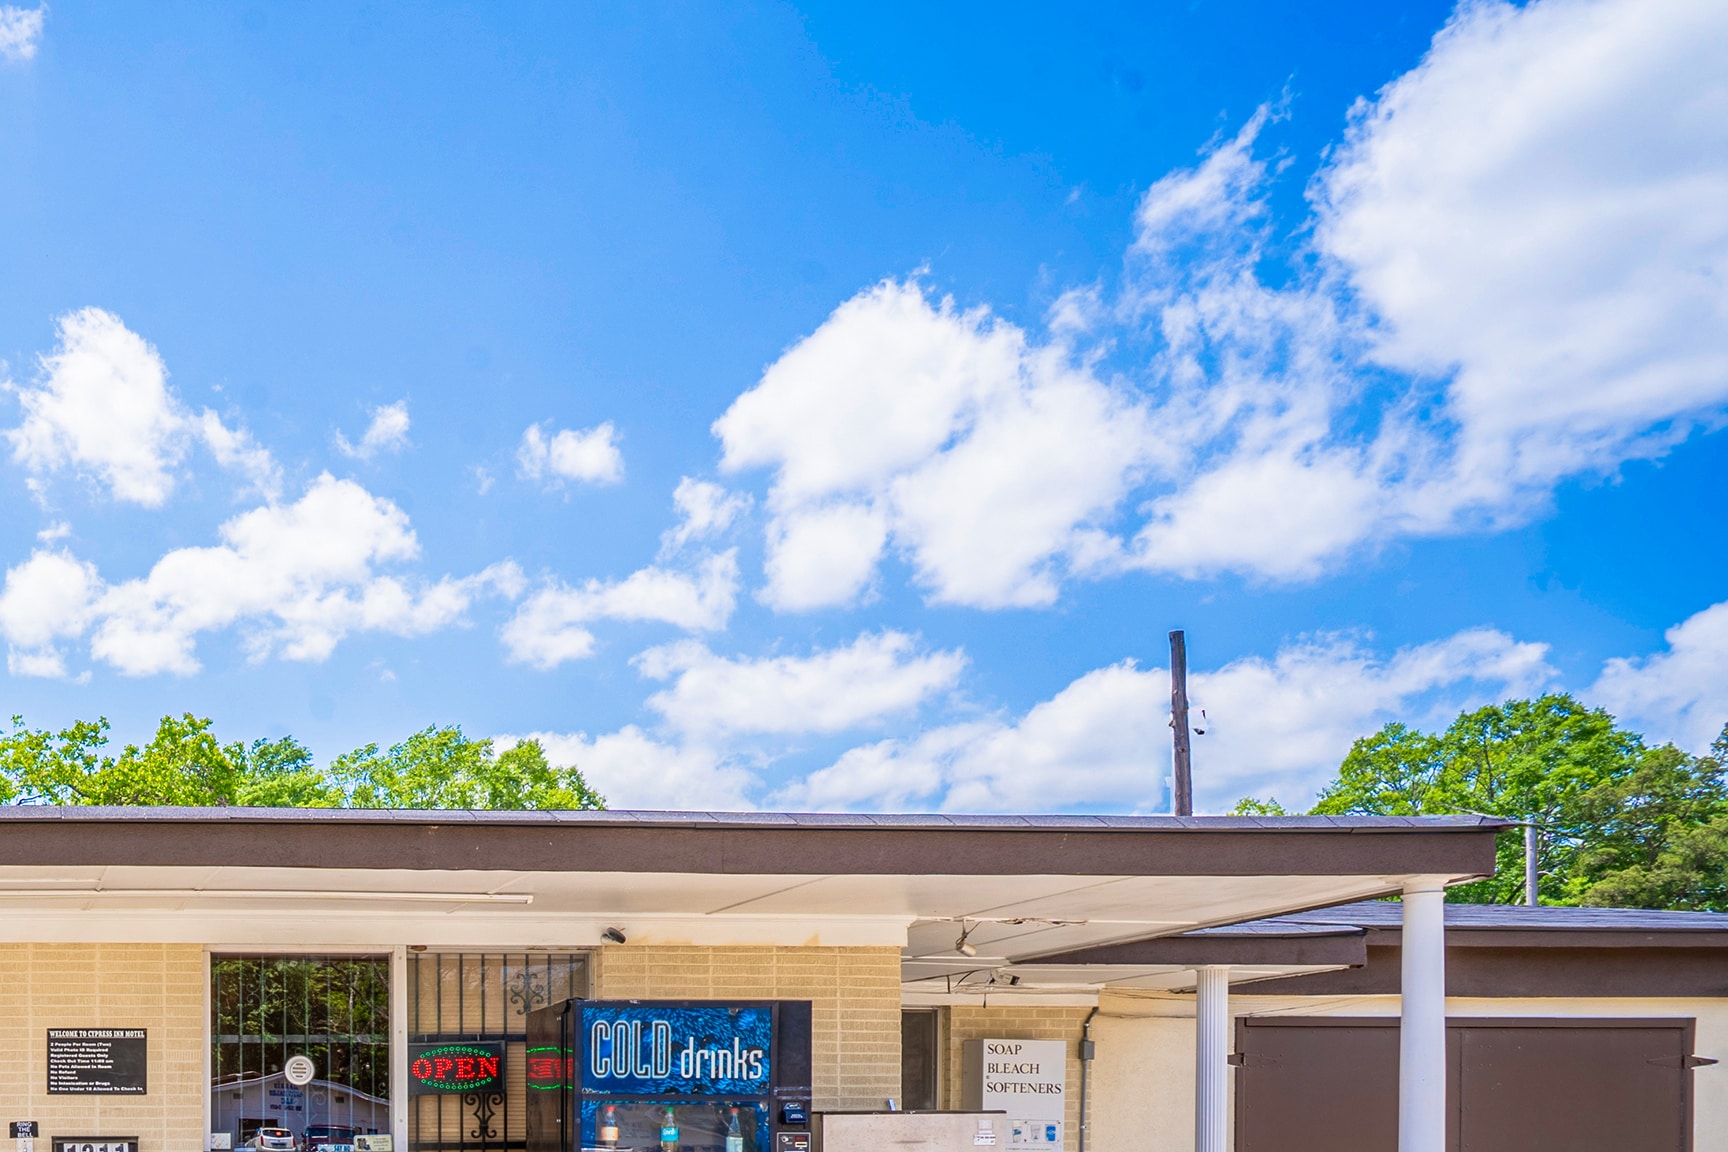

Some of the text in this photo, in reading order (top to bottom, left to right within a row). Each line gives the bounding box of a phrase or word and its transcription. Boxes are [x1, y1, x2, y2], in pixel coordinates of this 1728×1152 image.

[591, 1020, 672, 1079] COLD
[680, 1036, 763, 1081] drinks
[988, 1044, 1022, 1054] SOAP
[412, 1058, 499, 1078] OPEN
[988, 1063, 1040, 1074] BLEACH
[986, 1082, 1062, 1094] SOFTENERS
